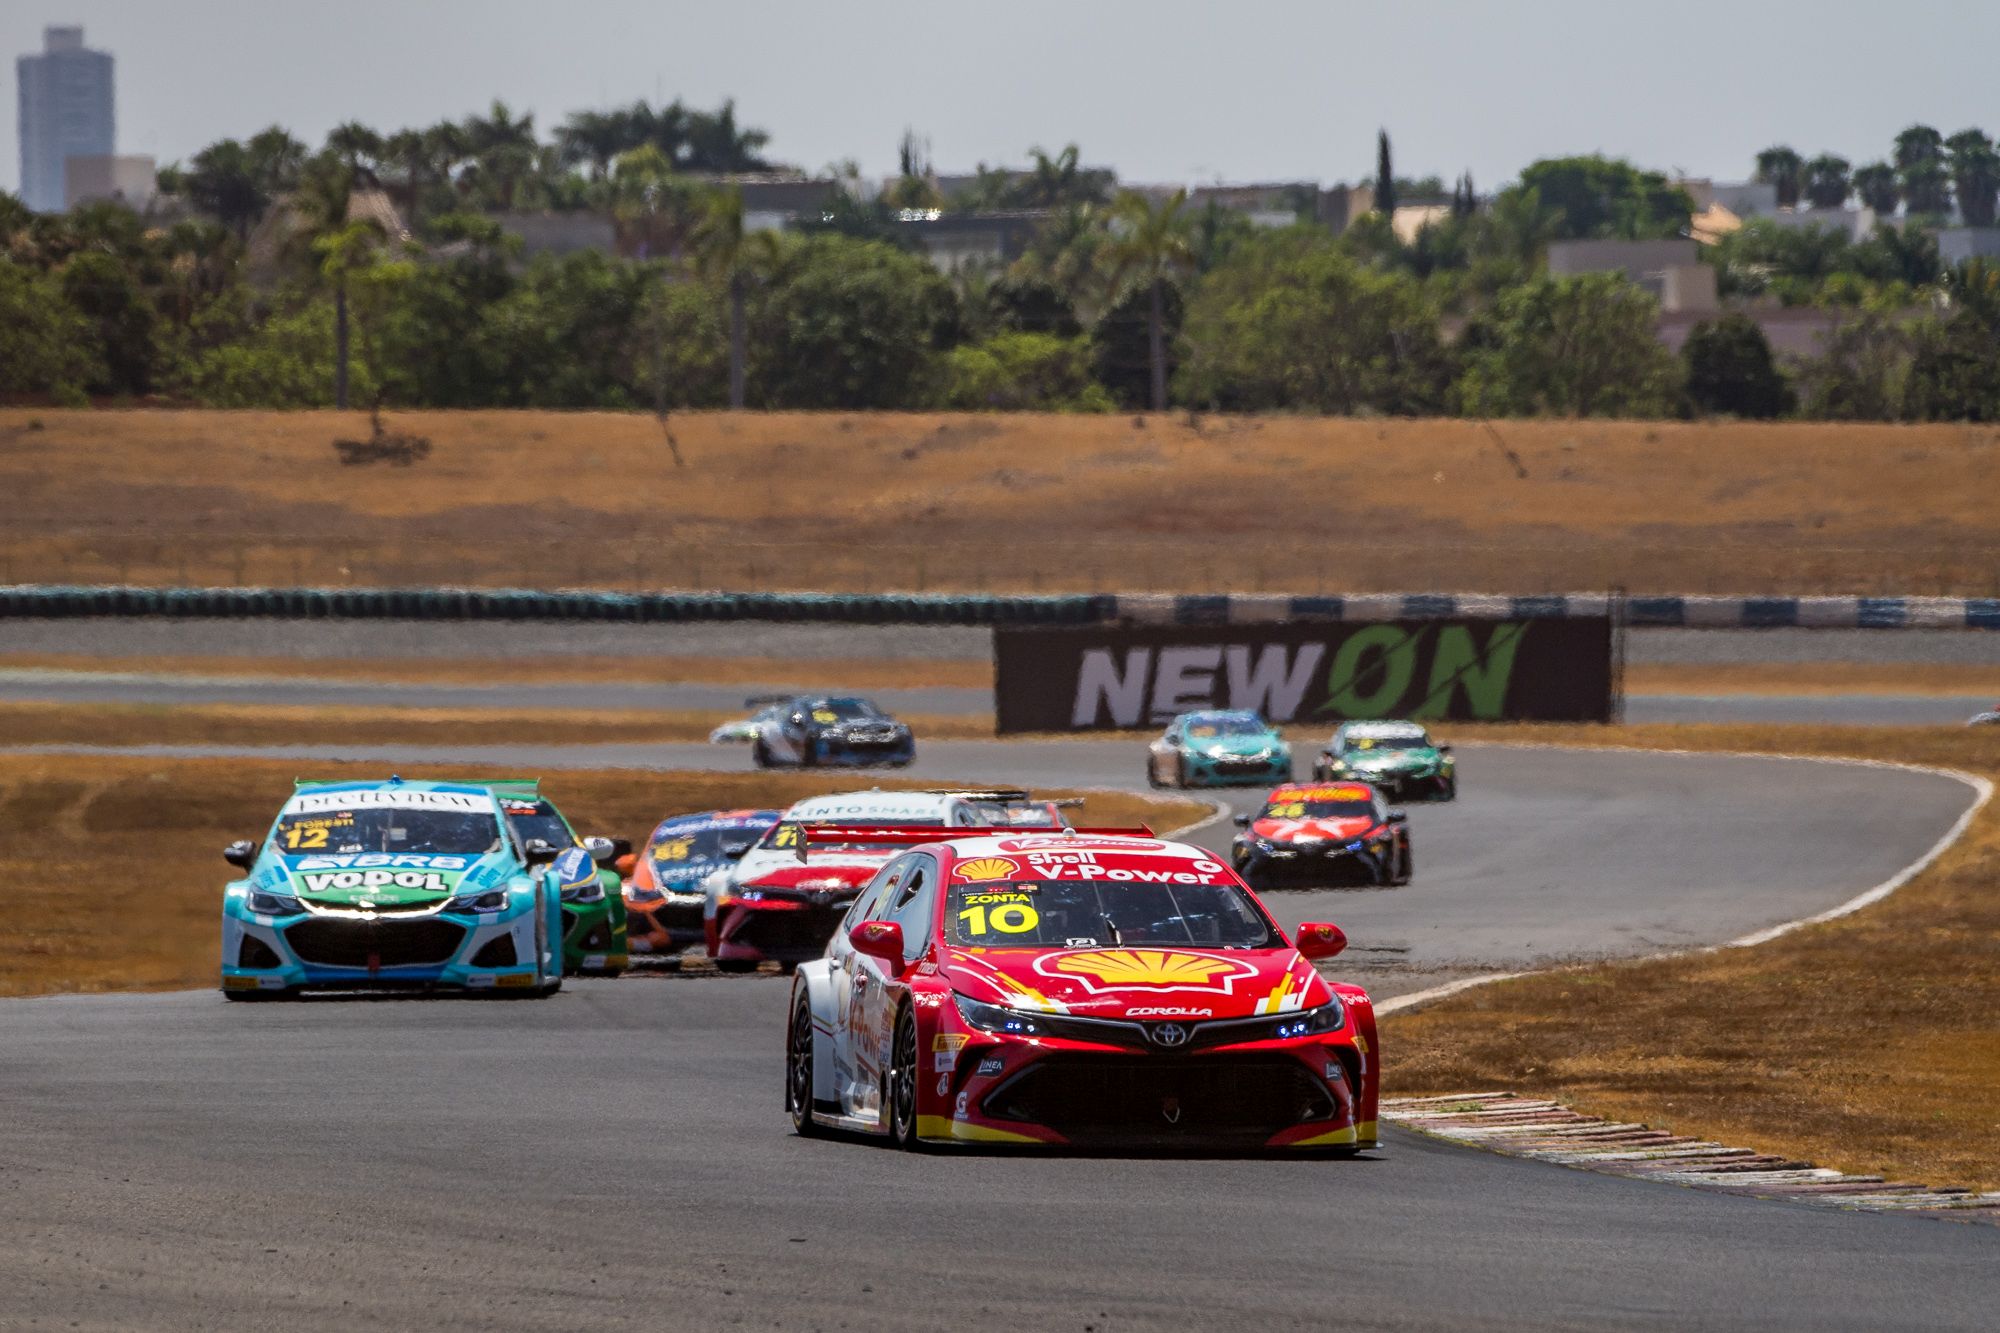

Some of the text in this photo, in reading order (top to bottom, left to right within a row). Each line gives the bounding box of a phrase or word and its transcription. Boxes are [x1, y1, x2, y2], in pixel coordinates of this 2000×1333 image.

[286, 828, 329, 849] 12
[353, 854, 467, 870] BRB
[1027, 852, 1097, 865] Shell
[303, 870, 450, 892] VODOL
[1032, 864, 1215, 885] V-Power
[965, 893, 1030, 905] ZONTA
[959, 903, 1039, 936] 10
[1125, 1007, 1213, 1017] COROLLA
